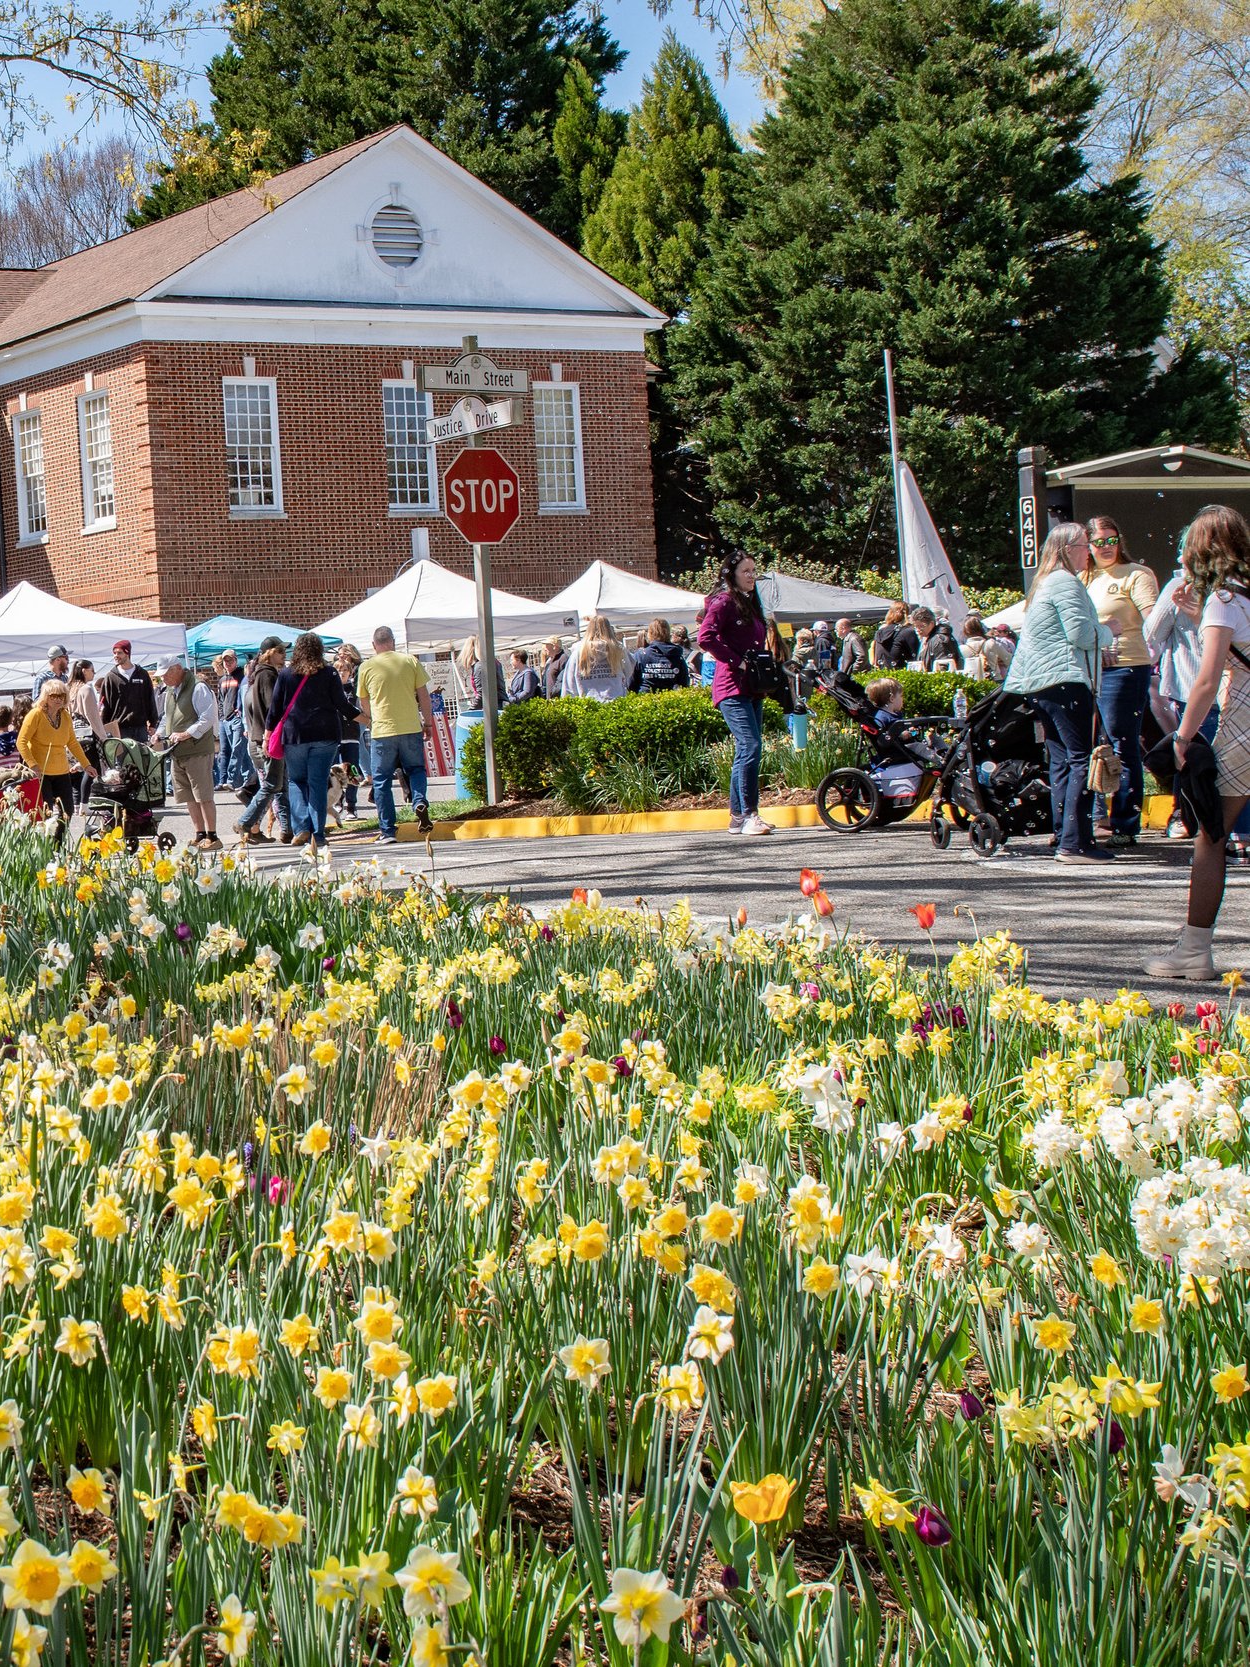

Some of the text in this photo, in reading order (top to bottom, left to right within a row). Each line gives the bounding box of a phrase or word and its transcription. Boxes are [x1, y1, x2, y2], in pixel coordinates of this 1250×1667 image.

[446, 370, 514, 387] Main Street
[433, 410, 498, 438] Justice Drive
[450, 478, 514, 514] STOP
[1022, 500, 1035, 566] 6467
